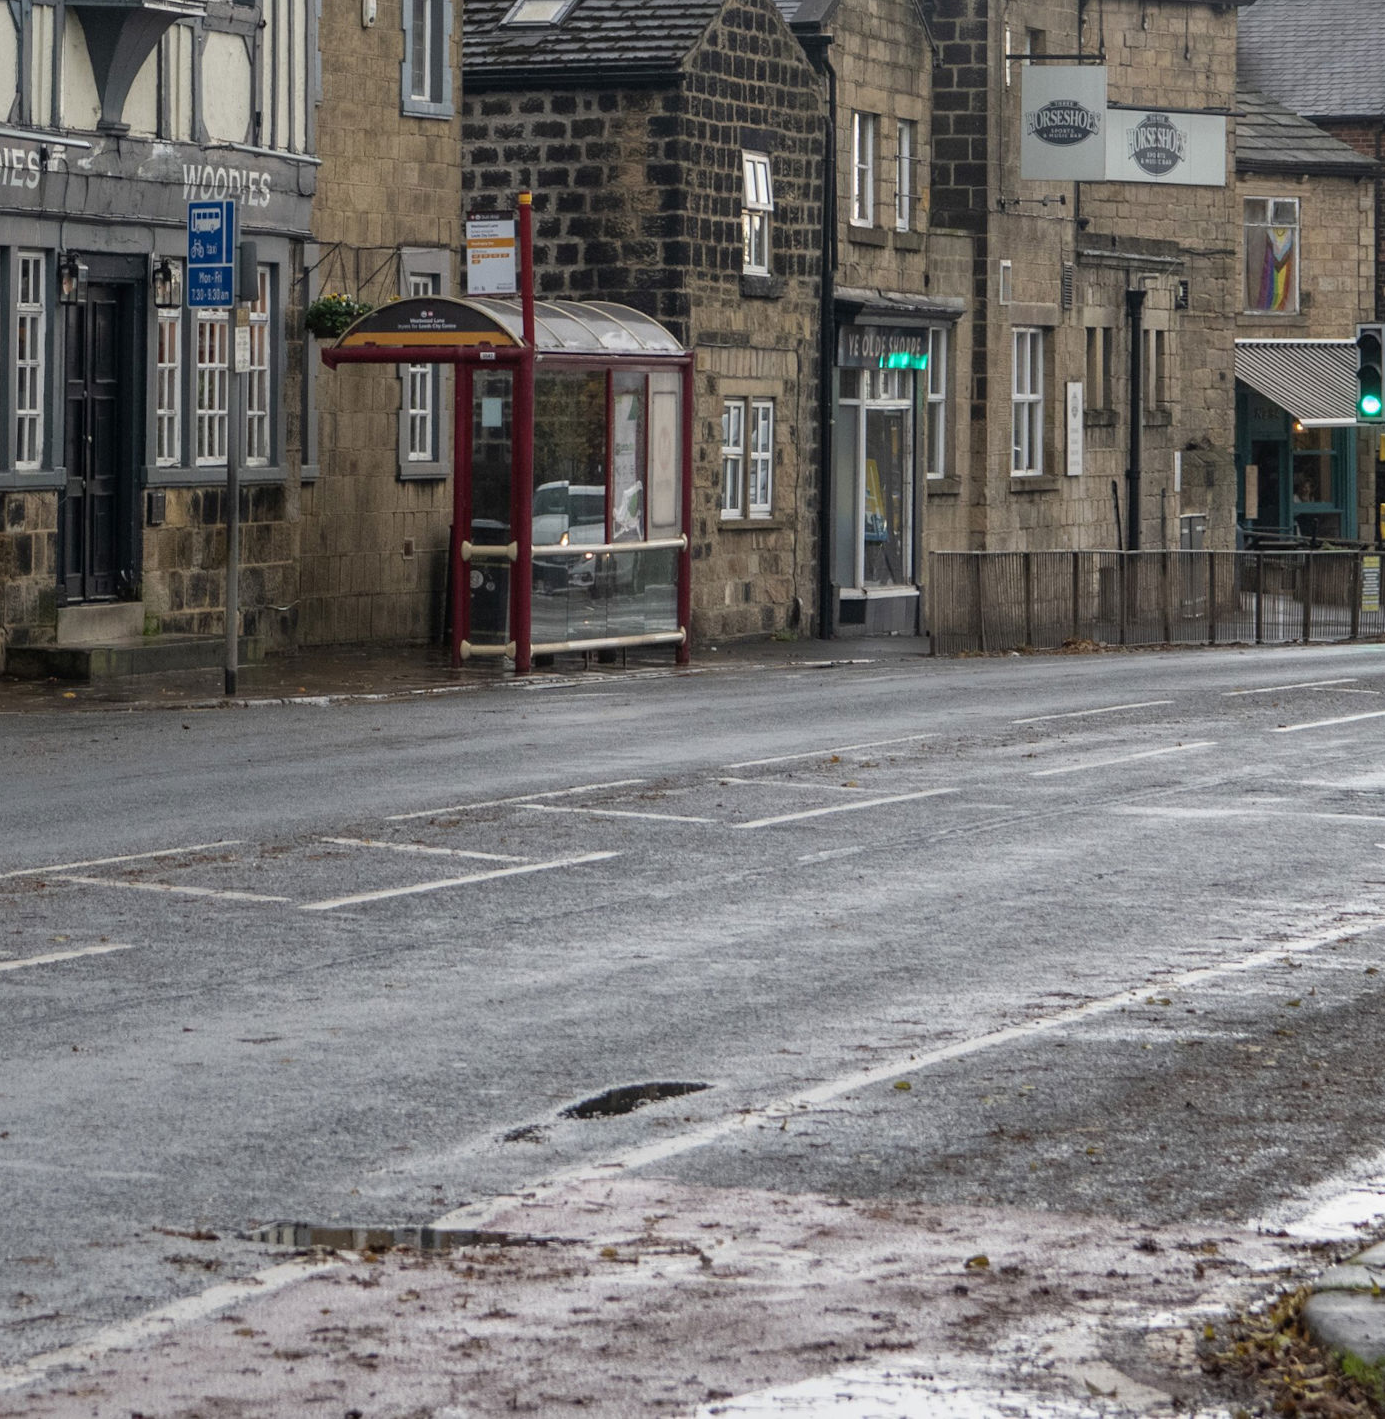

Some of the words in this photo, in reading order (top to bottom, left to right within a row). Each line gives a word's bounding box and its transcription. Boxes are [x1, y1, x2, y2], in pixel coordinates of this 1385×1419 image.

[1025, 109, 1102, 136] HORSESHOES
[182, 163, 272, 209] WOODIES
[205, 243, 218, 255] taxi
[198, 271, 211, 284] Mon
[214, 270, 223, 284] Fri
[848, 333, 860, 357] YE
[861, 334, 886, 358] OLDE
